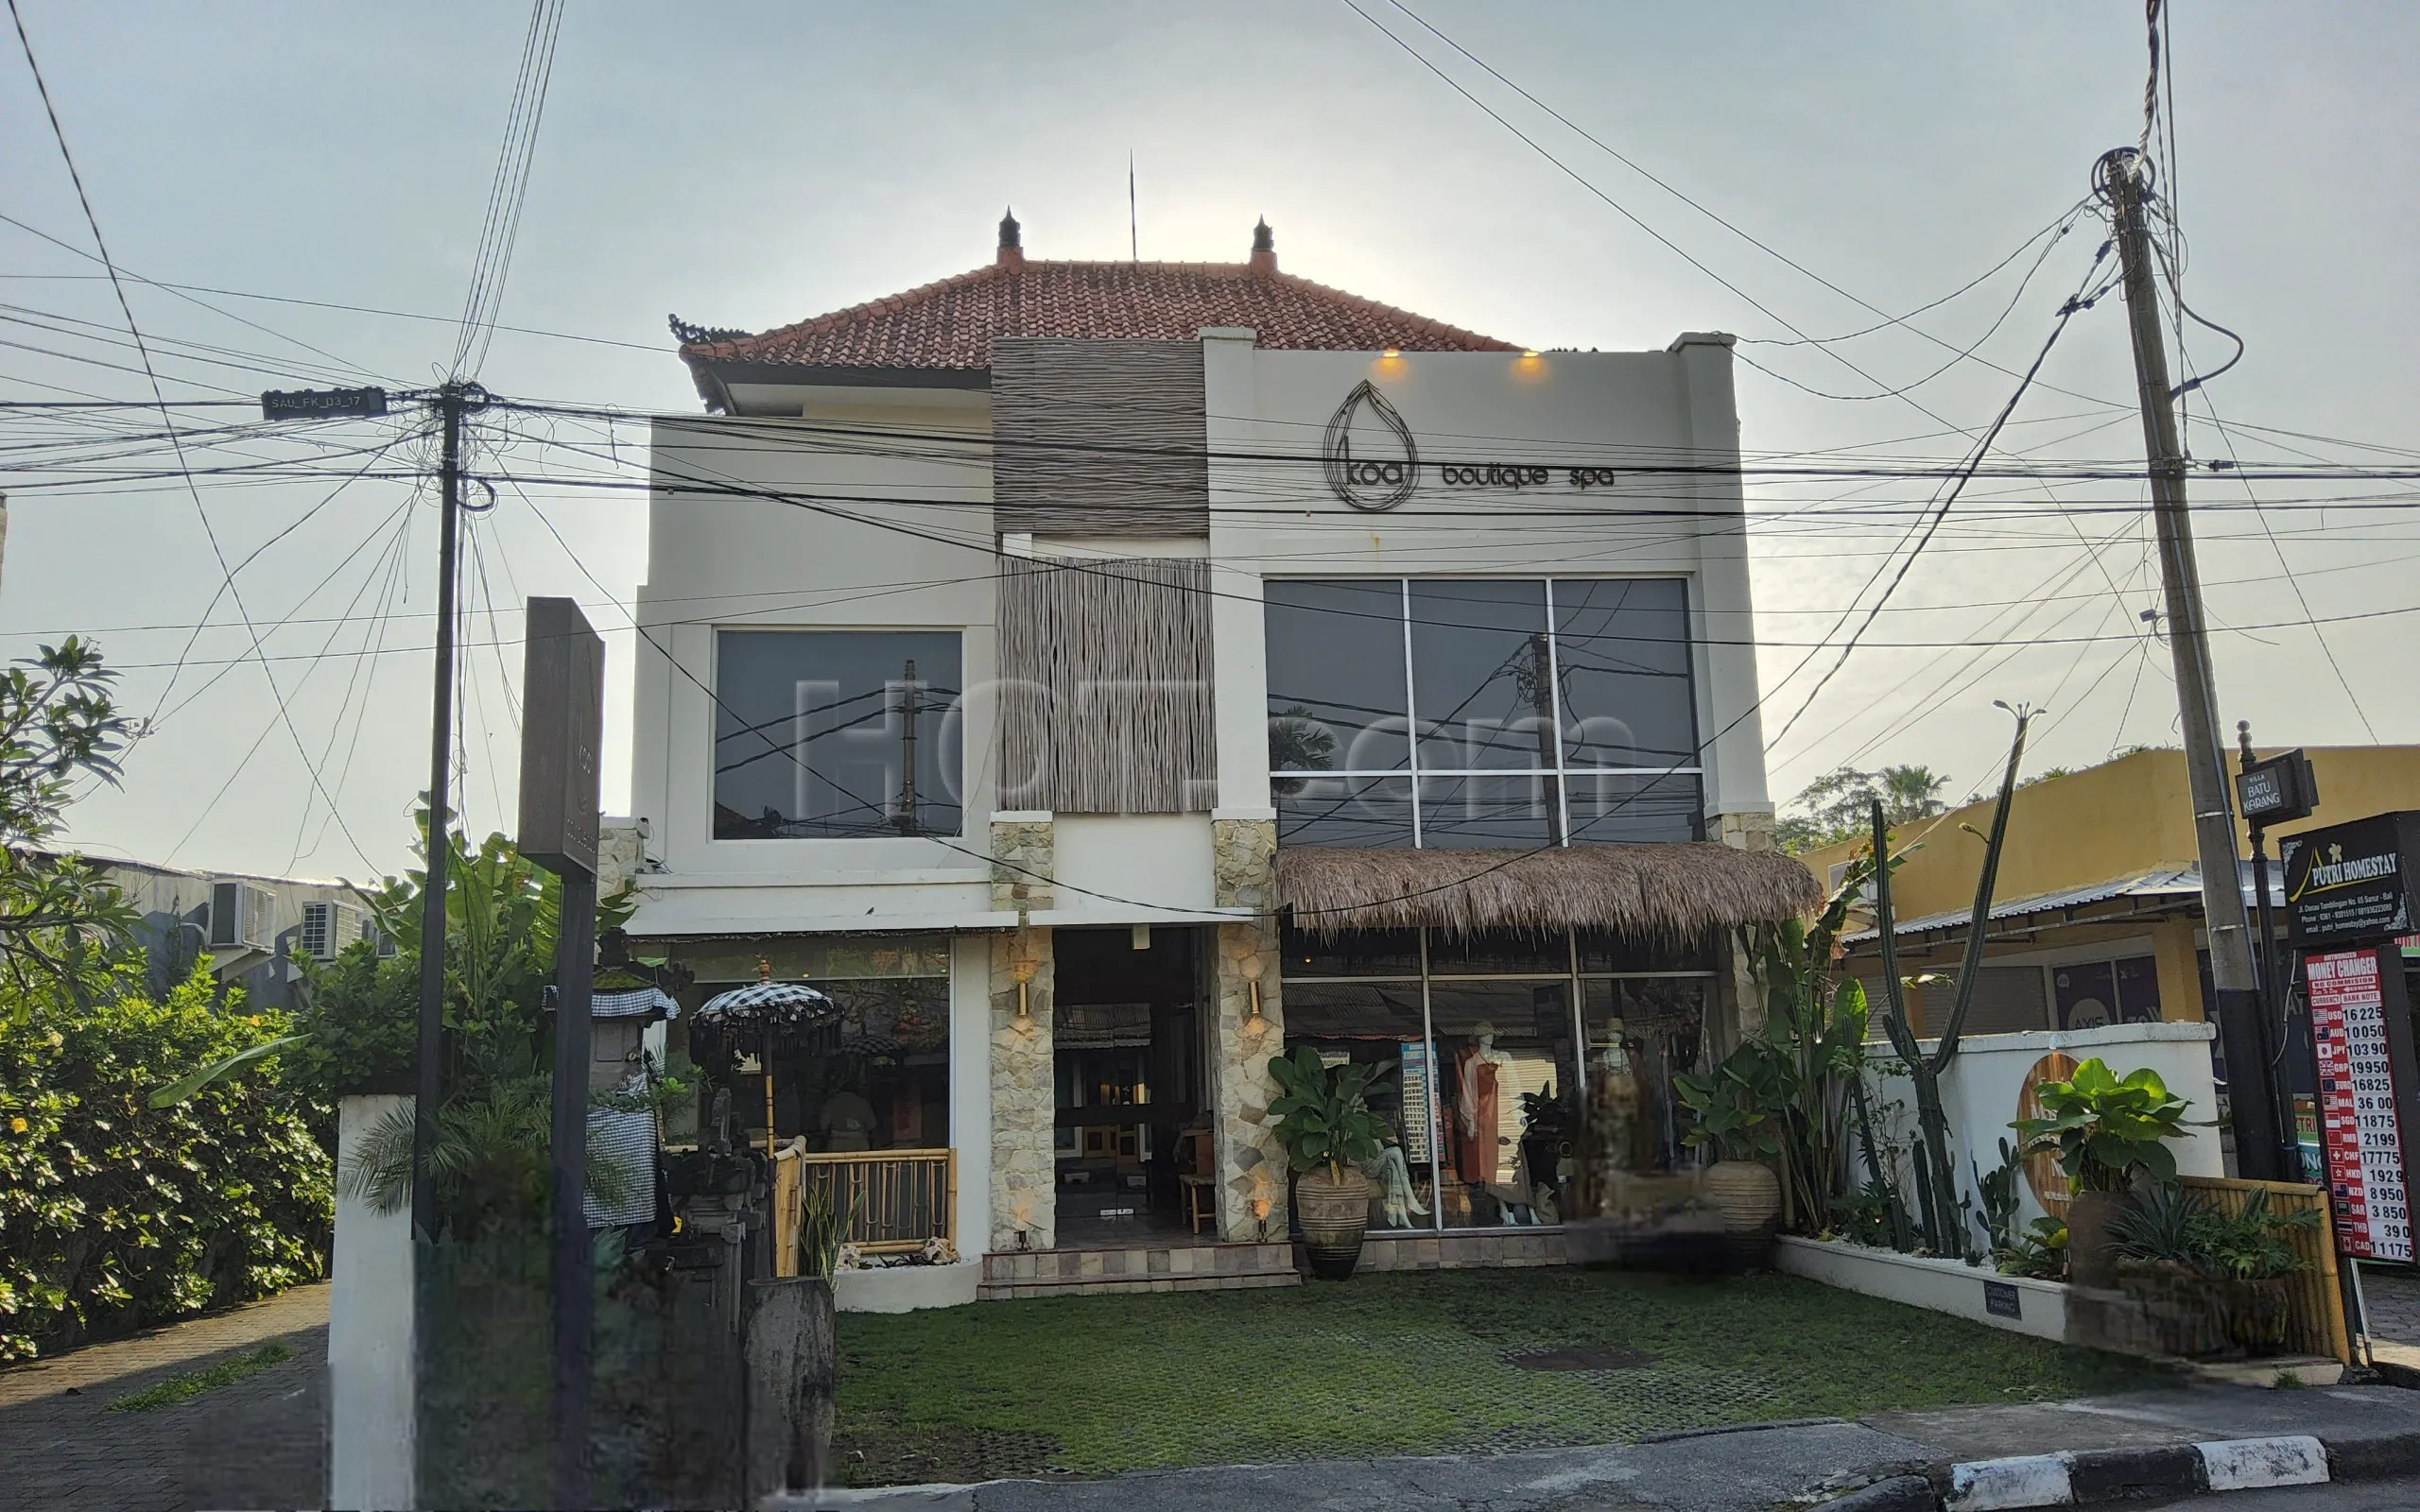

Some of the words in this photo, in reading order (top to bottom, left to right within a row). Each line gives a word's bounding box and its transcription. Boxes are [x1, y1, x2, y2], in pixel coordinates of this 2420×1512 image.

[1344, 436, 1404, 485] koa
[1443, 462, 1548, 490] boutique
[1569, 468, 1615, 490] spa
[2250, 774, 2265, 782] VILLA
[2248, 781, 2271, 798] BATU
[2243, 792, 2280, 813] KARANG
[2311, 864, 2343, 886] PUTRI
[2343, 852, 2396, 881] HOMESTAY
[2364, 895, 2379, 903] Sanur
[2382, 892, 2393, 901] Bali
[2301, 915, 2317, 923] Phone
[2306, 925, 2318, 934] email
[2308, 960, 2336, 980] MONEY
[2337, 956, 2377, 978] CHANGER
[2326, 977, 2374, 987] COMMISION
[2312, 996, 2340, 1005] CURRENCY
[2361, 992, 2377, 1001] NOTE
[2327, 1011, 2342, 1021] USD
[2330, 1028, 2343, 1038] AUD
[2345, 1025, 2385, 1039] 10050
[2332, 1046, 2345, 1056] JPY
[2334, 1063, 2348, 1073] GBP
[2350, 1061, 2389, 1074] 19950
[2336, 1081, 2352, 1091] EURO
[2352, 1079, 2390, 1091] 16825
[2338, 1099, 2354, 1108] MAL
[2341, 1116, 2355, 1125] SGD
[2355, 1115, 2394, 1127] 11875
[2342, 1134, 2357, 1143] RMB
[2364, 1133, 2395, 1146] 2199
[2344, 1152, 2360, 1160] CHF
[2360, 1151, 2400, 1164] 17775
[2346, 1169, 2361, 1178] HKD
[2370, 1169, 2403, 1182] 1929
[2348, 1187, 2363, 1196] NZD
[2351, 1204, 2365, 1215] SAR
[2353, 1222, 2368, 1233] THB
[2356, 1241, 2370, 1250] CAD
[2370, 1241, 2412, 1258] 11175
